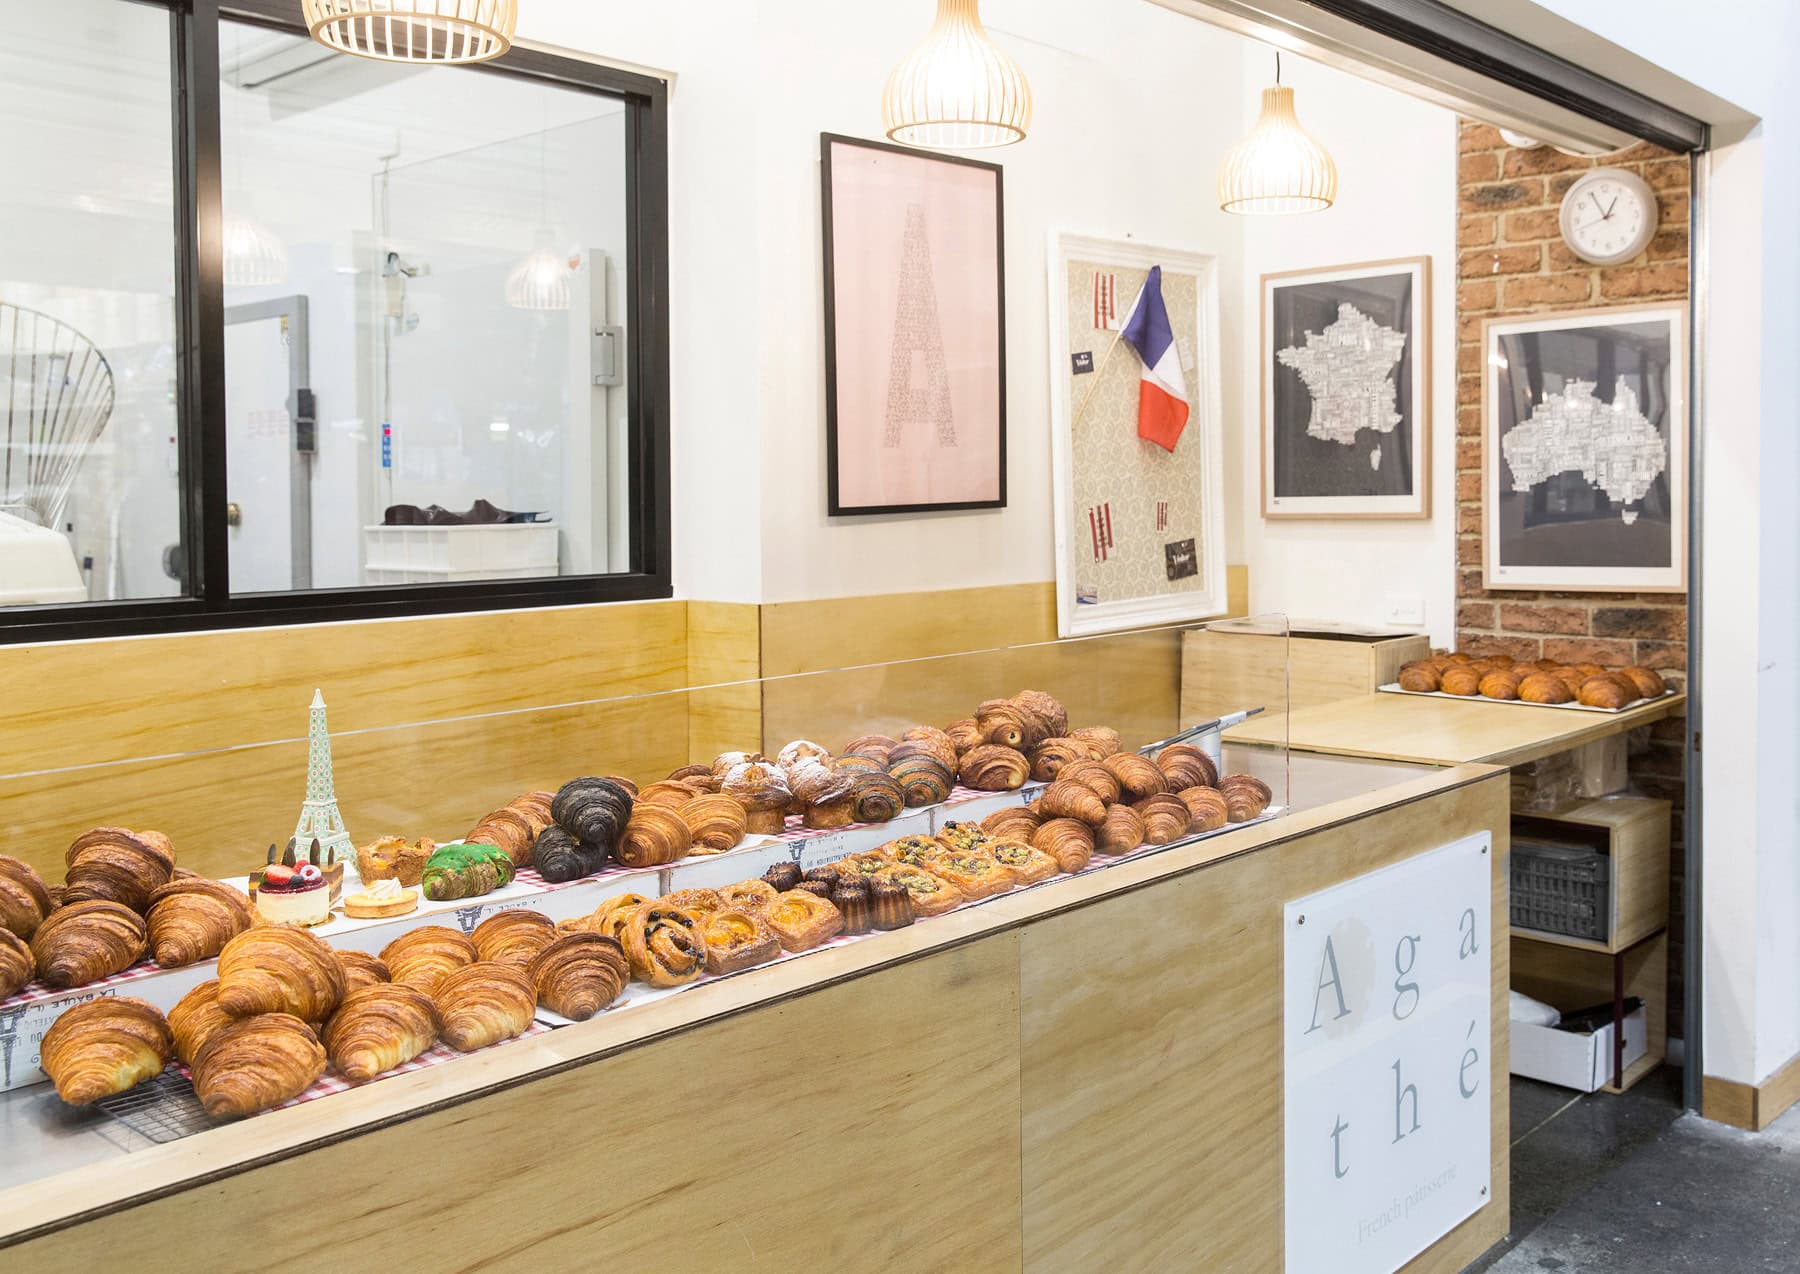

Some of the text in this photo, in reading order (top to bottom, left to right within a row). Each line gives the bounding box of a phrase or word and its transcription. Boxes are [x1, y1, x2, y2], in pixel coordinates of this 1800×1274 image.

[99, 988, 117, 998] LA
[1303, 907, 1479, 1036] Aga
[52, 993, 94, 1009] BAULE
[1329, 1020, 1480, 1180] thé
[1357, 1196, 1401, 1244] French
